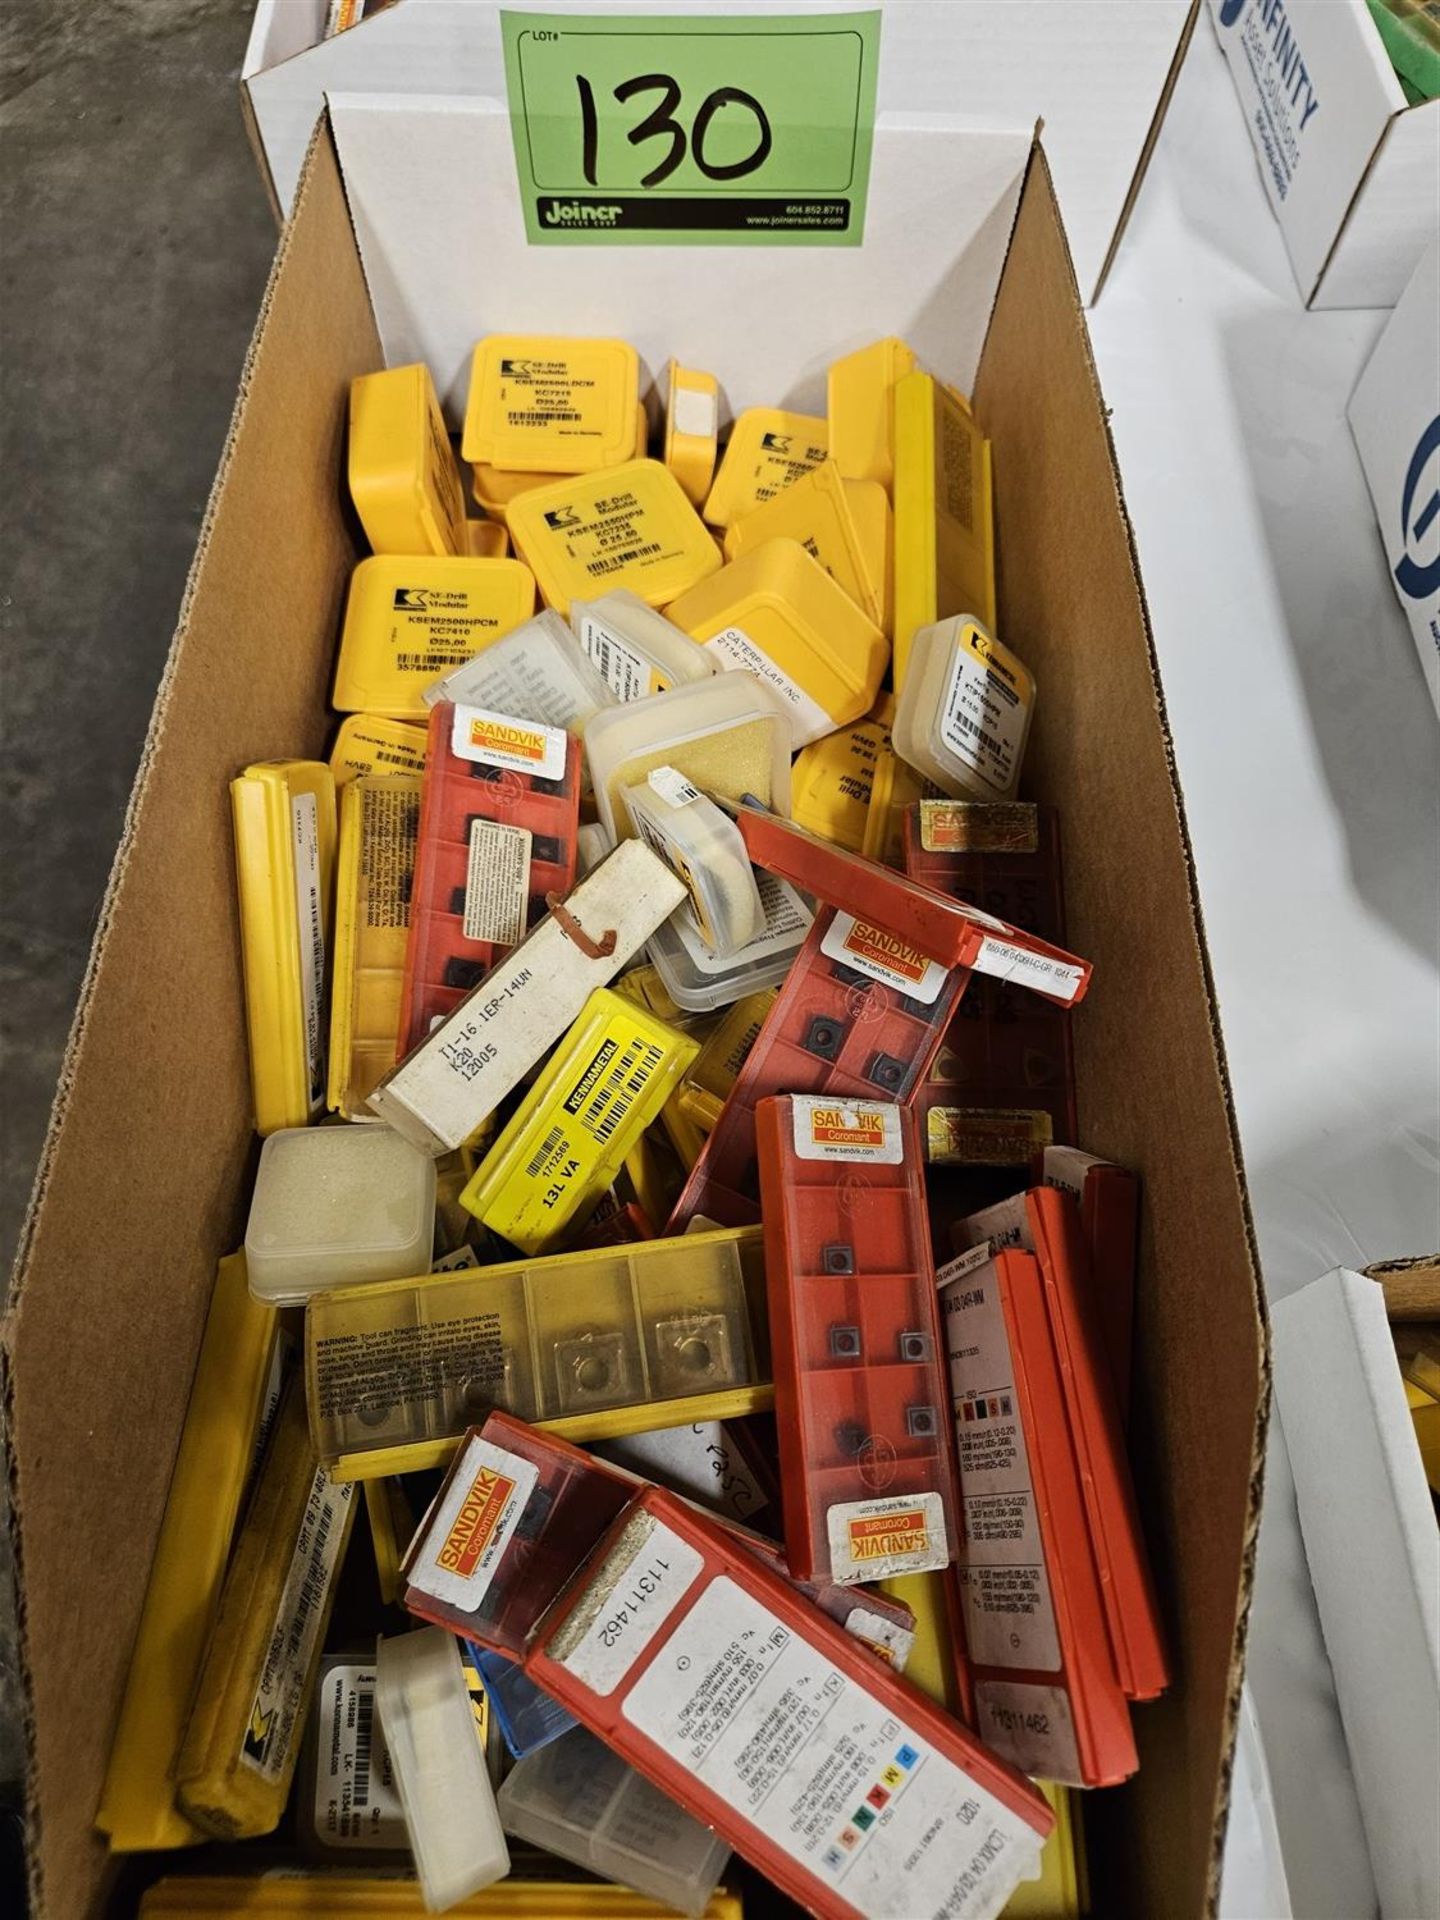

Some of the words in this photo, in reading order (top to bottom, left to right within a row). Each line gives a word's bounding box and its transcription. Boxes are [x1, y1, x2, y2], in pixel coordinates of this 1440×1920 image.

[532, 31, 559, 42] LOT#
[576, 73, 772, 190] 130
[726, 631, 784, 686] CATERPILLAR
[473, 721, 545, 749] SANDVIK
[853, 922, 927, 968] SANDVIK
[861, 944, 908, 972] Coromant
[448, 1046, 474, 1072] K20
[460, 1042, 498, 1080] 12005
[568, 1041, 618, 1109] KENNAMETAL
[814, 1111, 880, 1130] SANVIK
[828, 1130, 869, 1141] Coromant
[542, 1185, 565, 1207] 13L
[560, 1160, 579, 1176] VA
[439, 1472, 496, 1567] SANDVIK
[467, 1498, 501, 1555] Coromant
[865, 1517, 910, 1532] Coromant
[852, 1531, 927, 1558] SANDVIK
[597, 1557, 671, 1647] 11311462
[329, 1679, 343, 1776] www.kennametal.com
